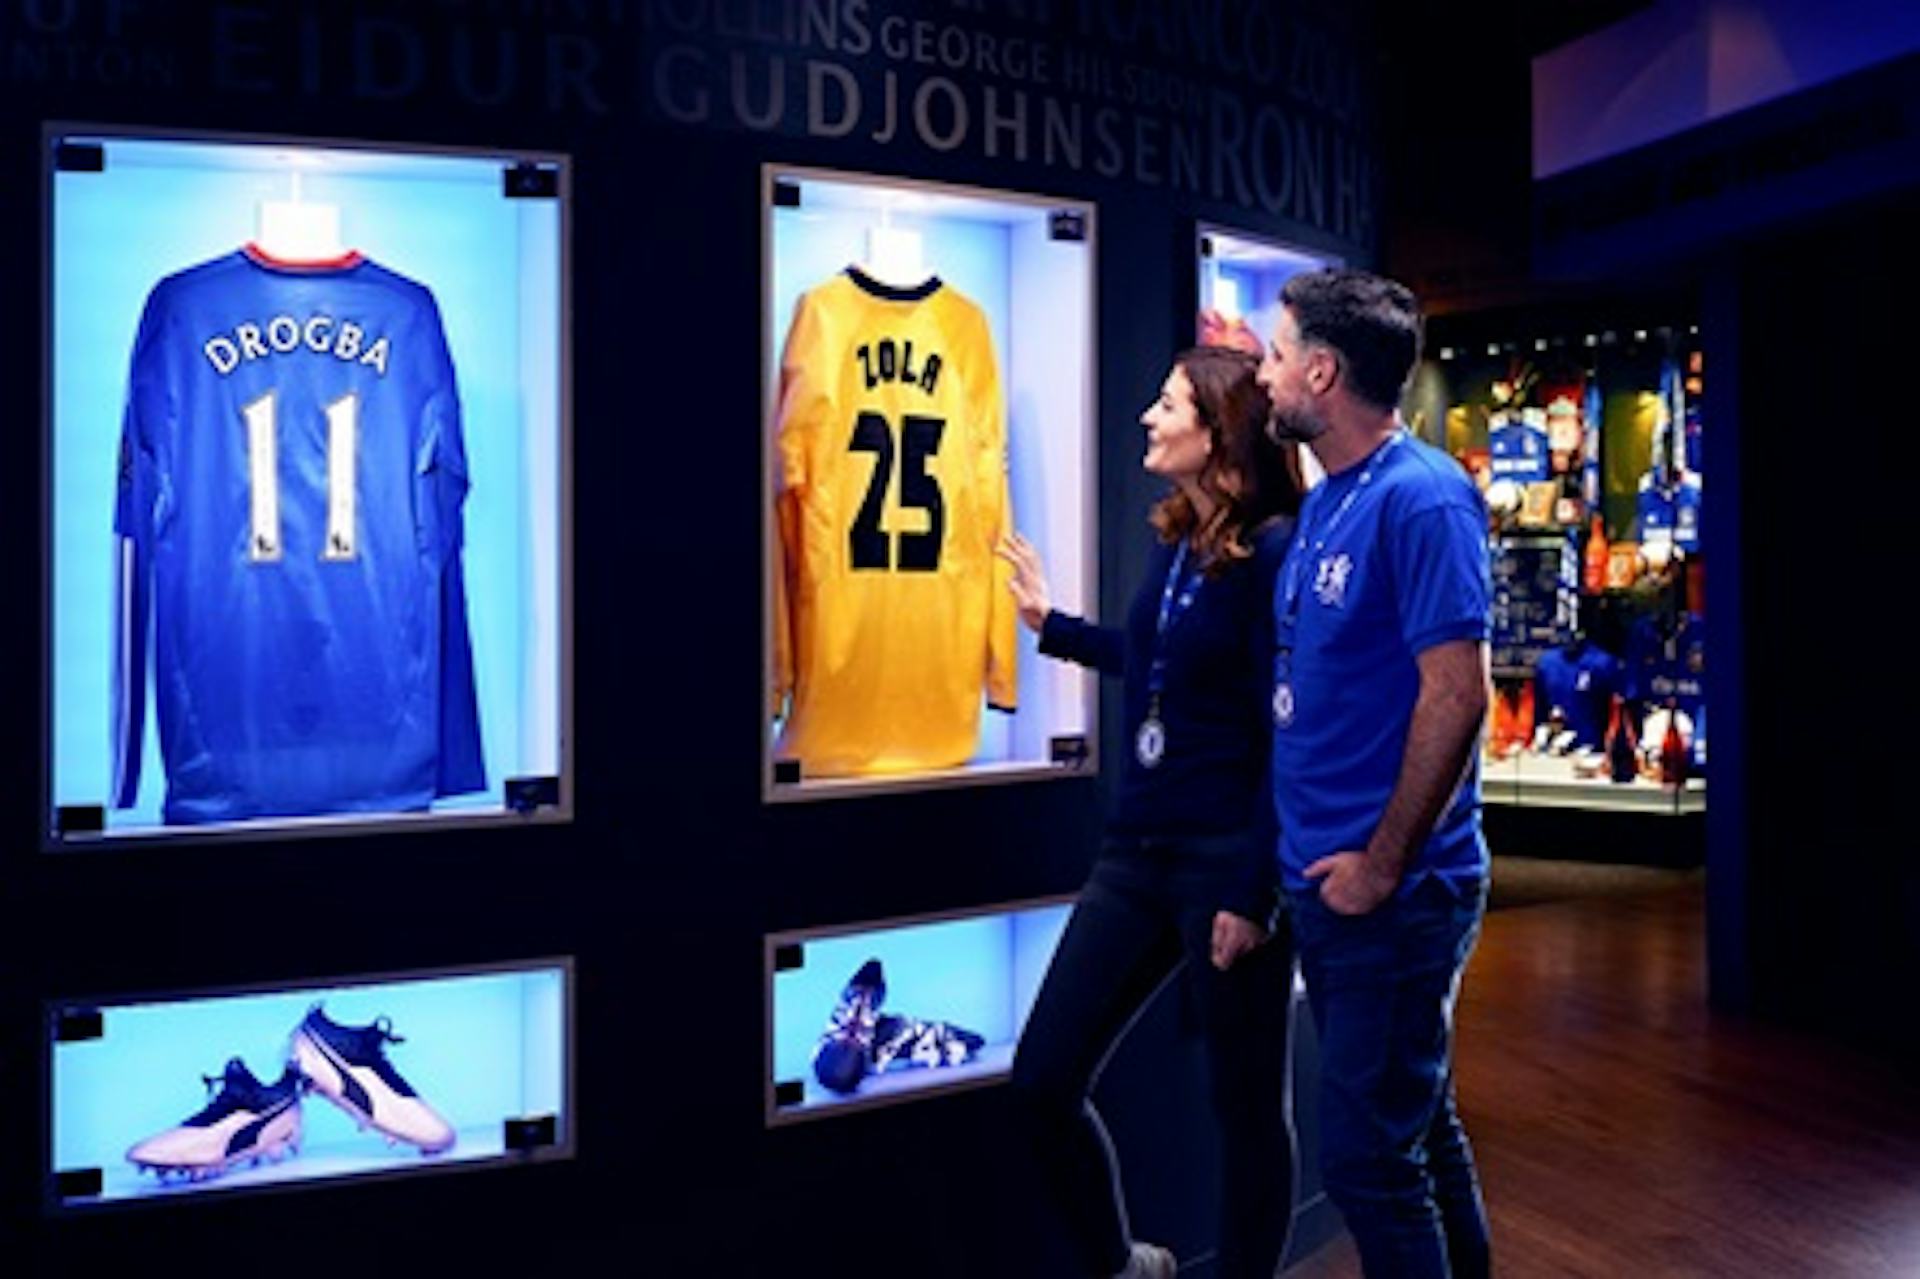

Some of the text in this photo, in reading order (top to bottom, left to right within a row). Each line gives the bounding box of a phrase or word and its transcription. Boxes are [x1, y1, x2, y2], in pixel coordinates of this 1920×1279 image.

[879, 16, 1052, 84] GEORGE
[210, 5, 610, 114] EIDUR
[652, 42, 1201, 190] GUDJOHNSEN
[1211, 88, 1325, 228] RON
[203, 315, 391, 375] DROGBA
[857, 338, 943, 396] ZOLA
[243, 388, 357, 563] 11
[848, 410, 947, 571] 25
